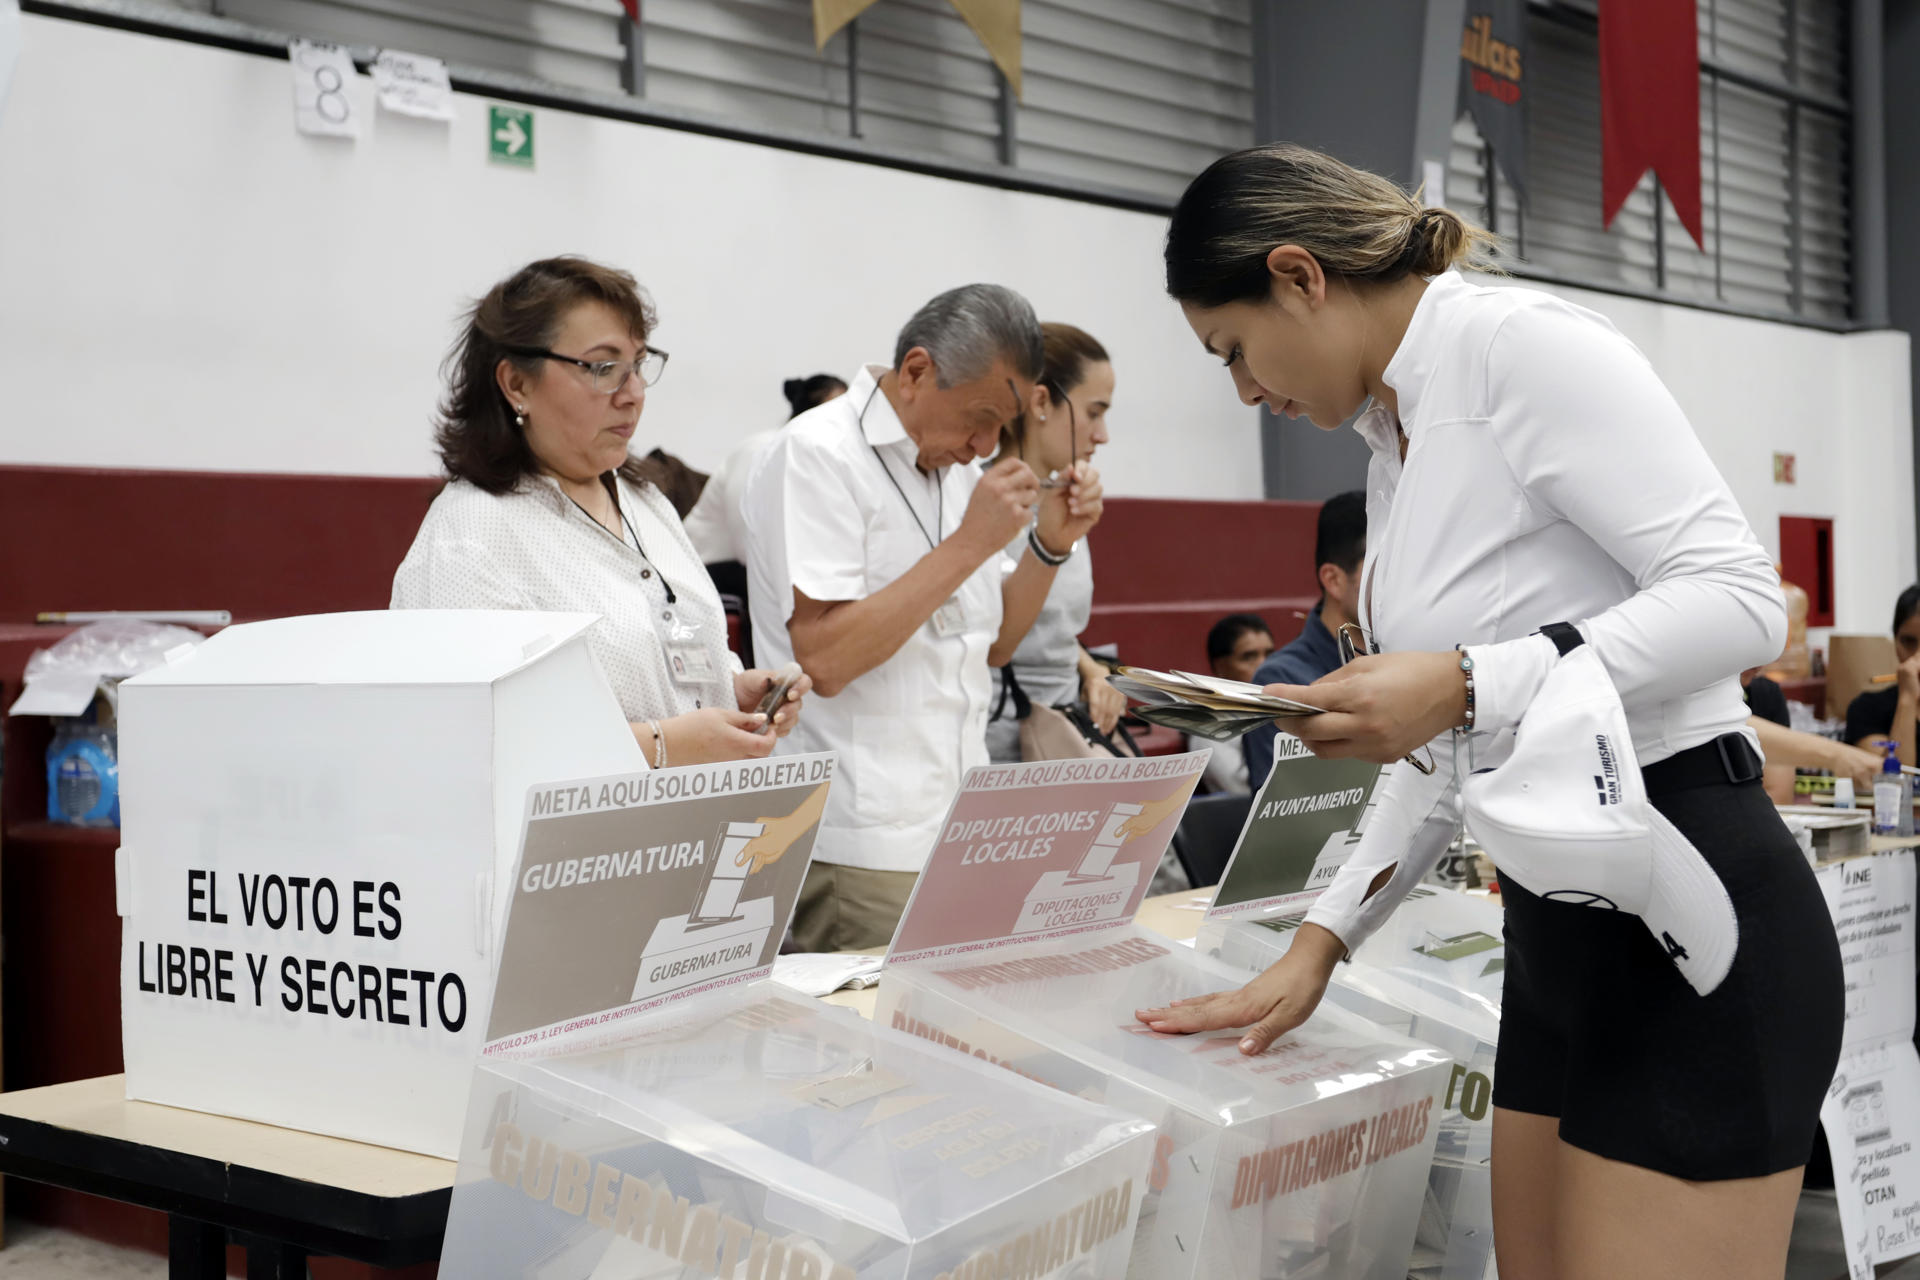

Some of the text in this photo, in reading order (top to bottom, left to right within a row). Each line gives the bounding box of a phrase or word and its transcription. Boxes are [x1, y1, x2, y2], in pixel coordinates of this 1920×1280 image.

[314, 64, 350, 124] 8
[966, 769, 1016, 789] META
[1019, 761, 1065, 785] AQUÍ
[1063, 762, 1107, 782] SOLO
[1109, 763, 1131, 780] LA
[1133, 760, 1188, 779] BOLETA
[1596, 734, 1615, 778] TURISMO
[532, 758, 834, 816] META AQUÍ SOLO LA BOLETA DE
[1259, 786, 1364, 820] AYUNTAMIENTO
[1607, 781, 1619, 805] GRAN
[944, 809, 1100, 843] DIPUTACIONES
[522, 839, 705, 893] GUBERNATURA
[960, 837, 1055, 866] LOCALES
[1852, 867, 1873, 885] INE
[188, 869, 402, 941] EL VOTO ES
[1031, 891, 1122, 916] DIPUTACIONES
[1044, 907, 1100, 928] LOCALES
[650, 942, 753, 982] GUBERNATURA
[944, 947, 956, 956] LEY
[957, 943, 985, 954] GENERAL
[139, 940, 467, 1033] LIBRE Y SECRETO
[549, 1026, 562, 1038] LEY
[564, 1016, 598, 1033] GENERAL
[600, 1013, 611, 1024] DE
[611, 999, 663, 1020] INSTITUCIONES
[669, 979, 726, 1003] PROCEDIMIENTOS
[727, 967, 771, 986] ELECTORALES
[1231, 1118, 1367, 1210] DIPUTACIONES
[1365, 1096, 1433, 1165] LOCALES
